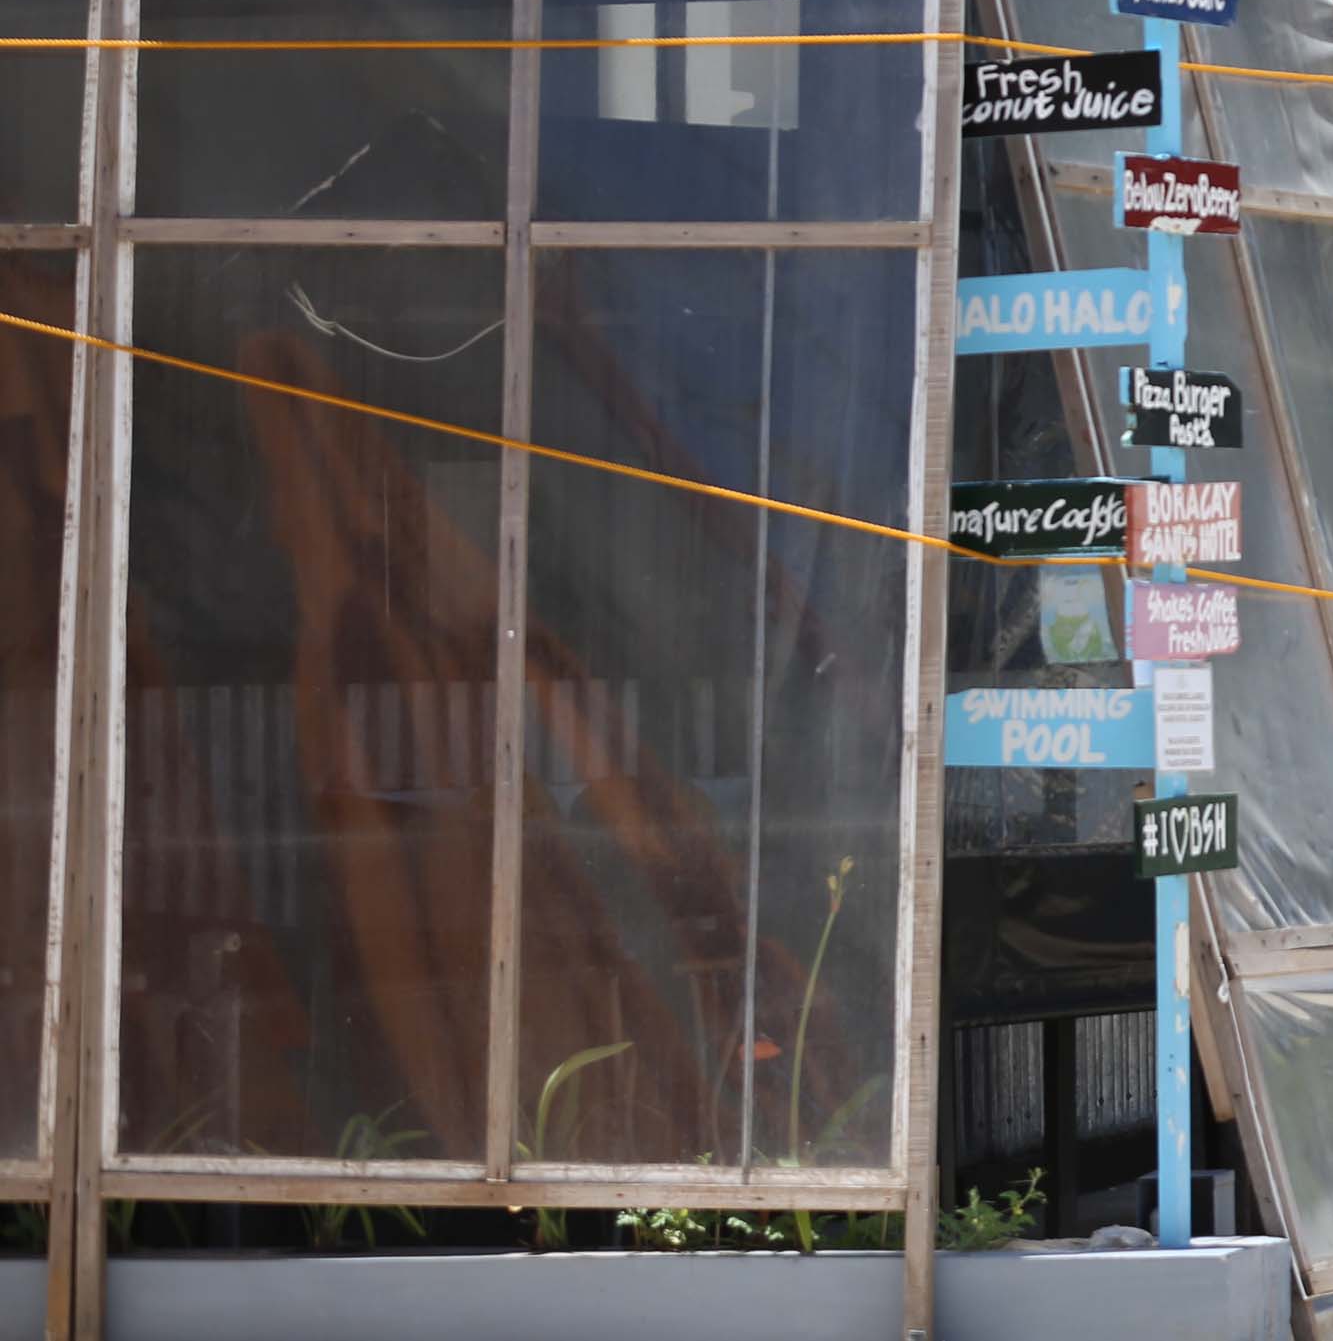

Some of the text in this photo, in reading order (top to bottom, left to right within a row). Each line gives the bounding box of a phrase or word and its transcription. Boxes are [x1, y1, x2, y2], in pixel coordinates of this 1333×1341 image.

[977, 60, 1082, 98] Fresh
[1044, 287, 1152, 335] HALO
[962, 688, 1136, 723] SWIMMING
[1002, 720, 1106, 764] POOL
